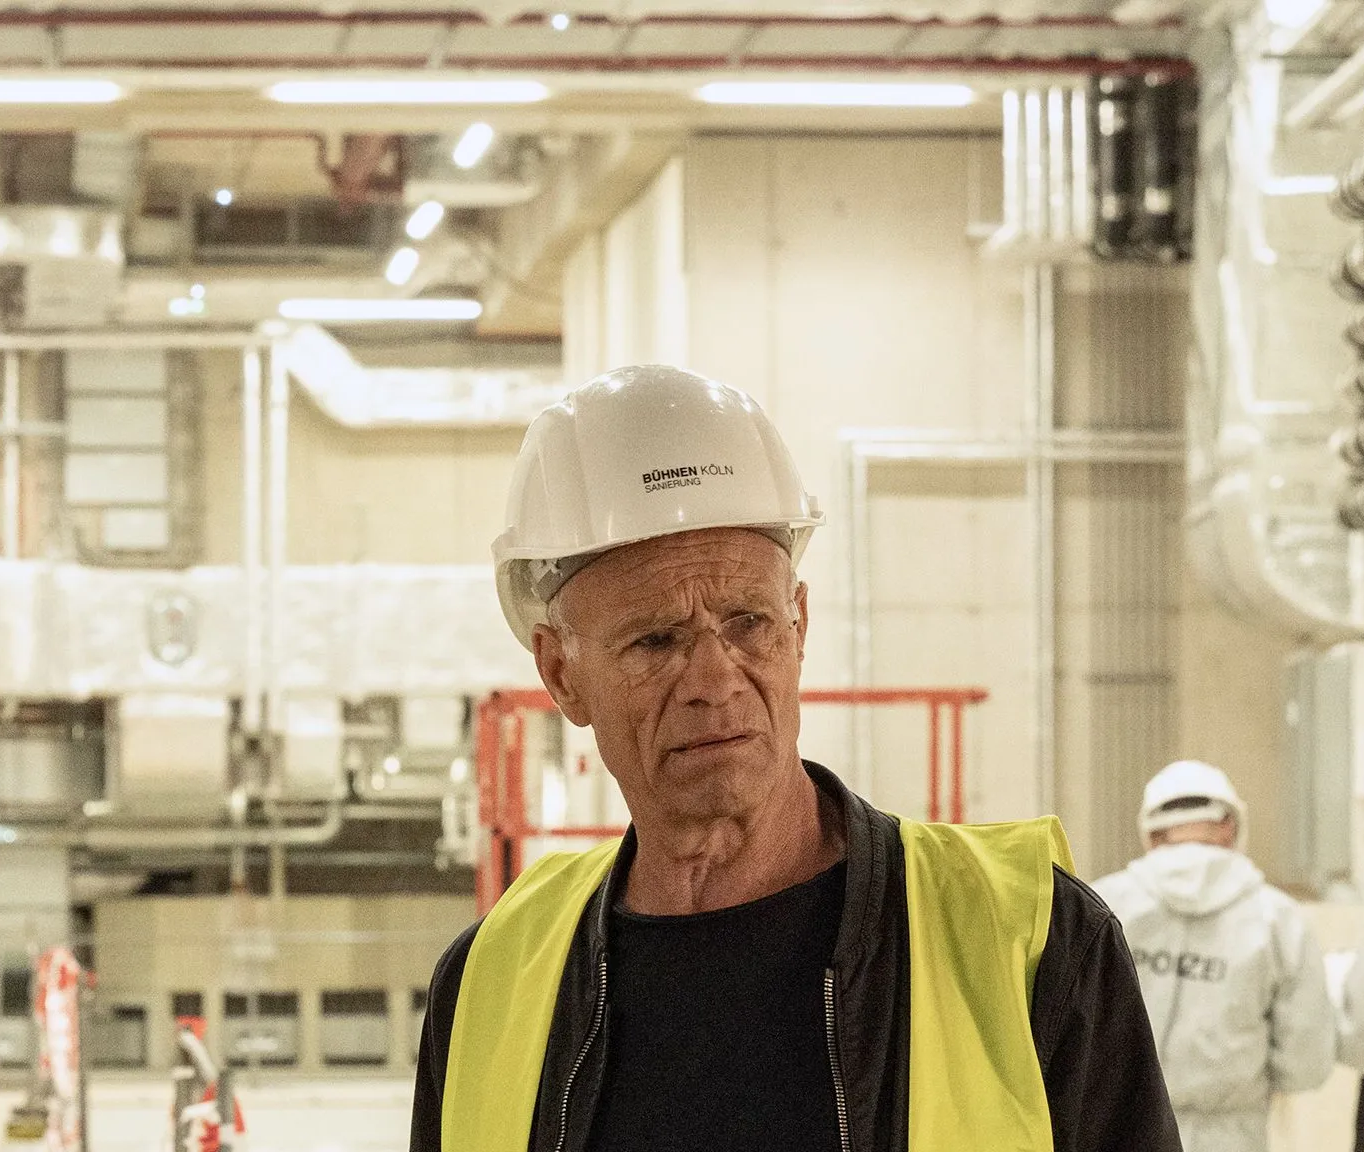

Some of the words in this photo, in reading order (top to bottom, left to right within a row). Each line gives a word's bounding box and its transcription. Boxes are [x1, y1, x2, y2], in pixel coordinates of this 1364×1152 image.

[642, 465, 698, 484] BÜHNEN
[701, 463, 734, 476] KÖLN
[644, 477, 702, 493] SANIERUNG
